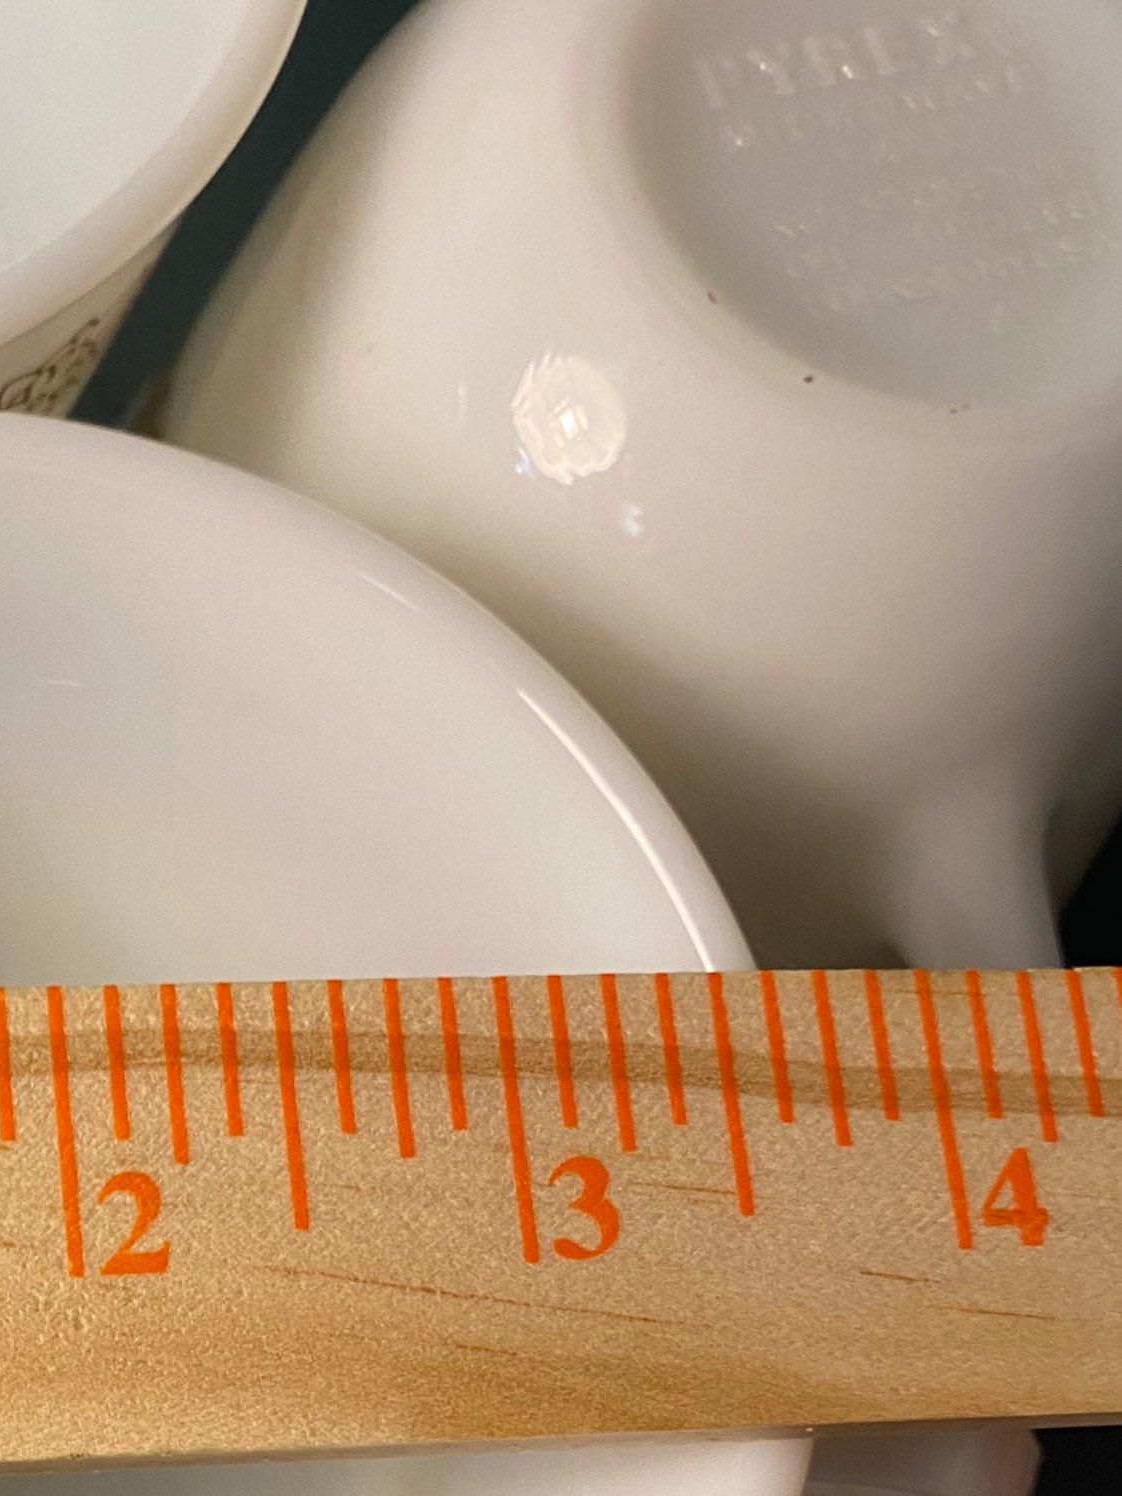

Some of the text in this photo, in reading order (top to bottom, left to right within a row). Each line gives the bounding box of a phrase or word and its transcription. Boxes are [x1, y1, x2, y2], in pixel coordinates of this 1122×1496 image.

[99, 1171, 170, 1275] 2
[548, 1154, 621, 1261] 3
[979, 1147, 1050, 1248] 4
